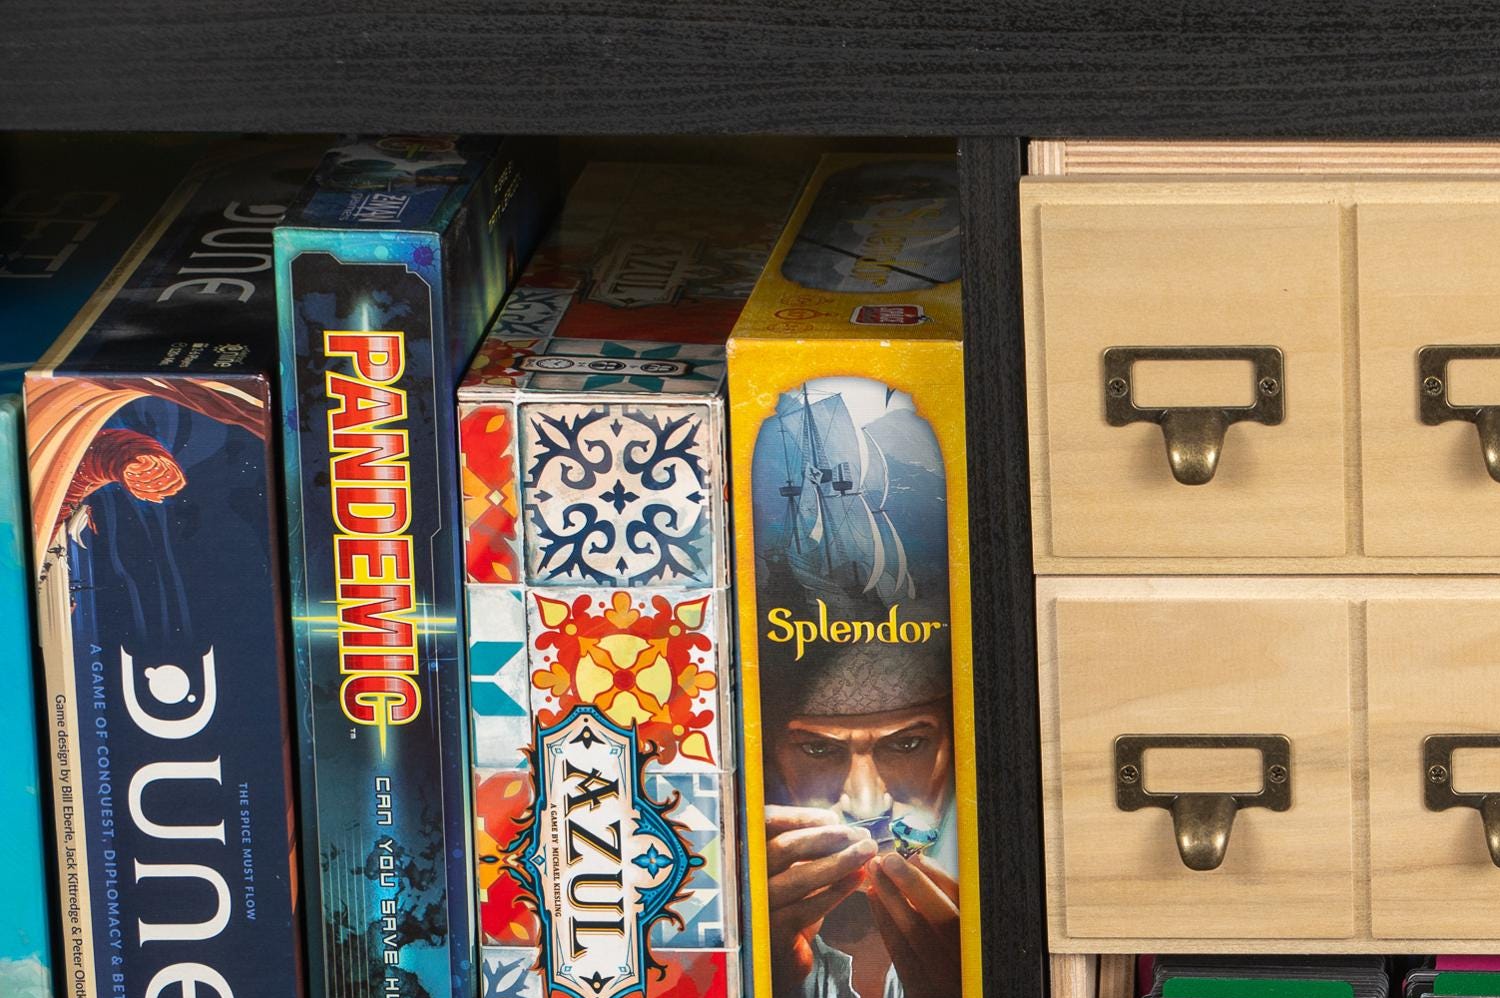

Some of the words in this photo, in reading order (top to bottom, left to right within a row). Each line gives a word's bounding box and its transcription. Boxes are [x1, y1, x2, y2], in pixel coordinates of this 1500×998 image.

[323, 329, 422, 727] PANDEMIC
[767, 598, 941, 662] Splendor
[90, 643, 102, 655] A
[91, 662, 106, 710] GAME
[55, 694, 67, 727] Game
[95, 716, 108, 739] OF
[57, 729, 69, 767] design
[59, 767, 70, 784] by
[61, 785, 73, 804] Bill
[97, 745, 115, 843] CONQUEST,
[238, 782, 248, 806] THE
[375, 776, 392, 825] CAN
[63, 805, 76, 844] Eberle,
[240, 810, 252, 844] SPICE
[550, 810, 558, 833] GAME
[552, 833, 559, 844] BY
[65, 846, 75, 870] Jack
[242, 848, 254, 882] MUST
[378, 839, 395, 887] YOU
[552, 847, 561, 883] MICHAEL
[562, 758, 626, 962] AZUL
[67, 872, 81, 924] Kittredge
[104, 849, 122, 950] DIPLOMACY
[245, 886, 256, 921] FLOW
[554, 885, 562, 918] KIESLING
[71, 926, 82, 937] &
[381, 899, 399, 966] SAVE
[72, 938, 83, 968] Peter
[111, 955, 123, 966] &
